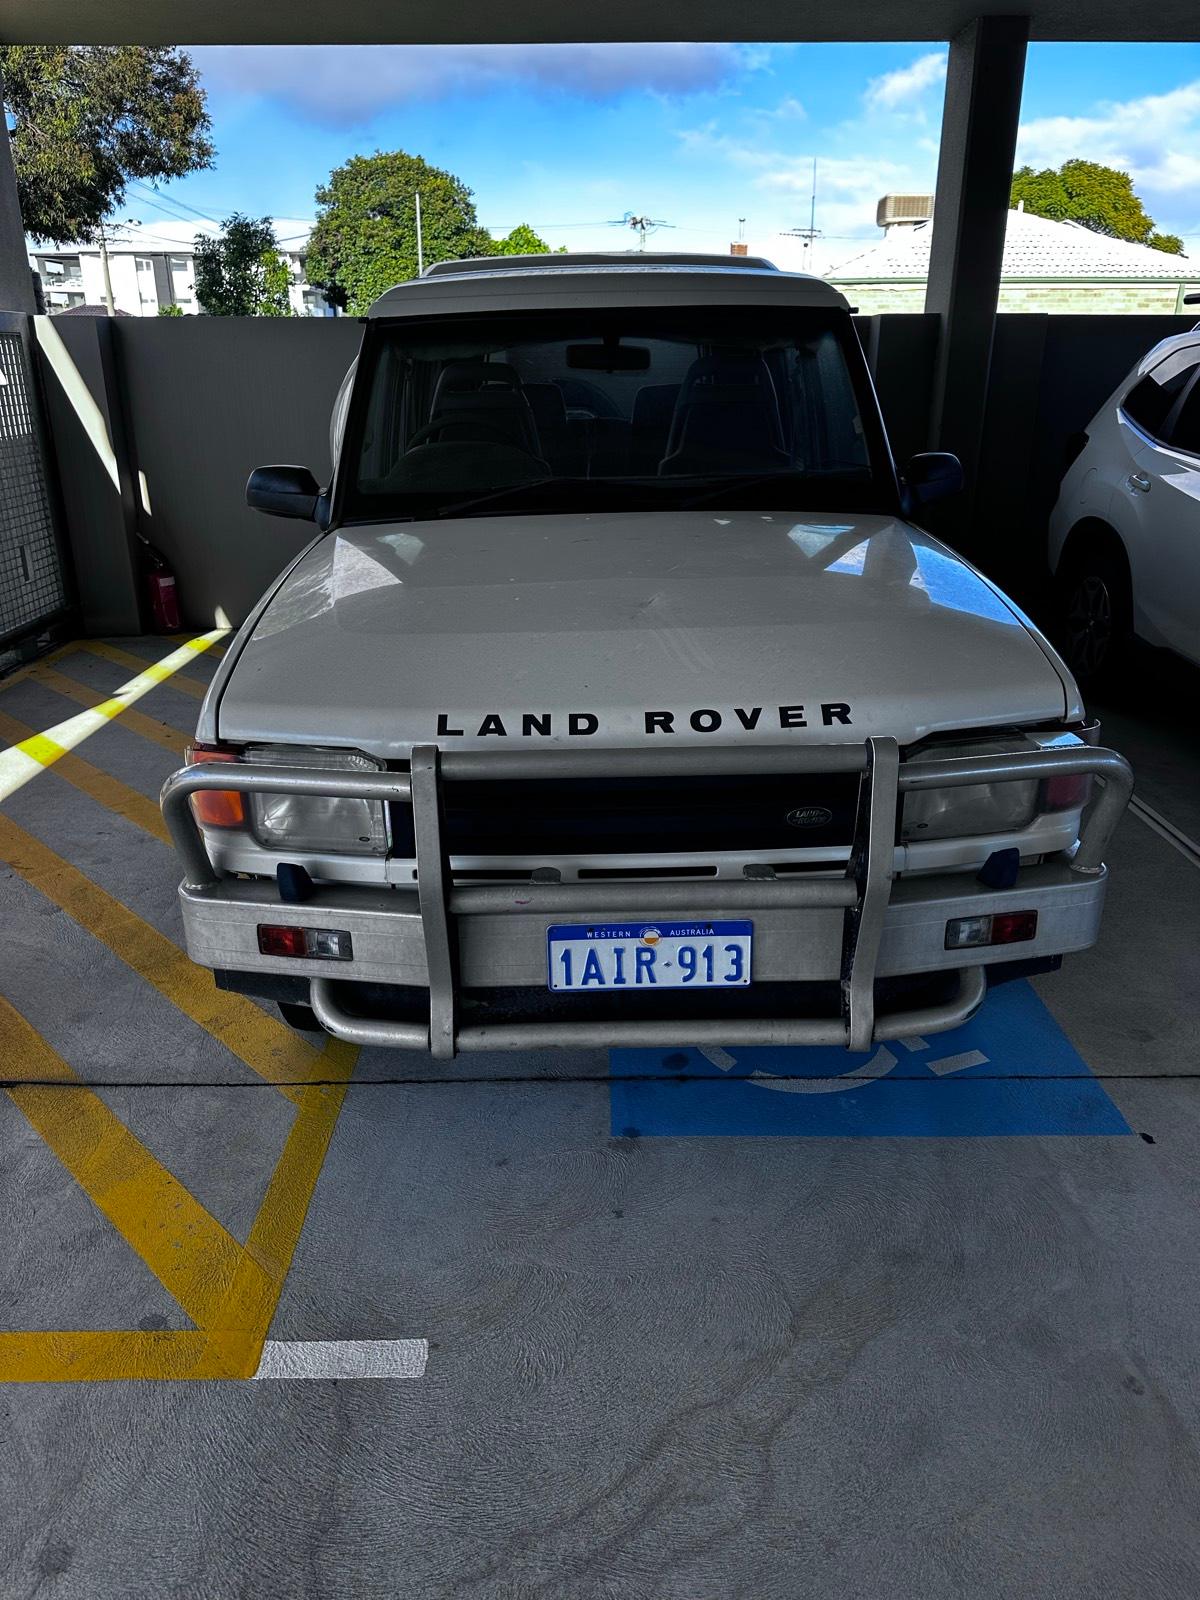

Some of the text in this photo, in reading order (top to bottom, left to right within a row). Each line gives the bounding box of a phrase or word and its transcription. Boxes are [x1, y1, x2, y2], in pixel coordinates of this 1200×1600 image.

[437, 703, 853, 736] LAND ROVER
[586, 928, 715, 938] WESTERN AUSTRALIA
